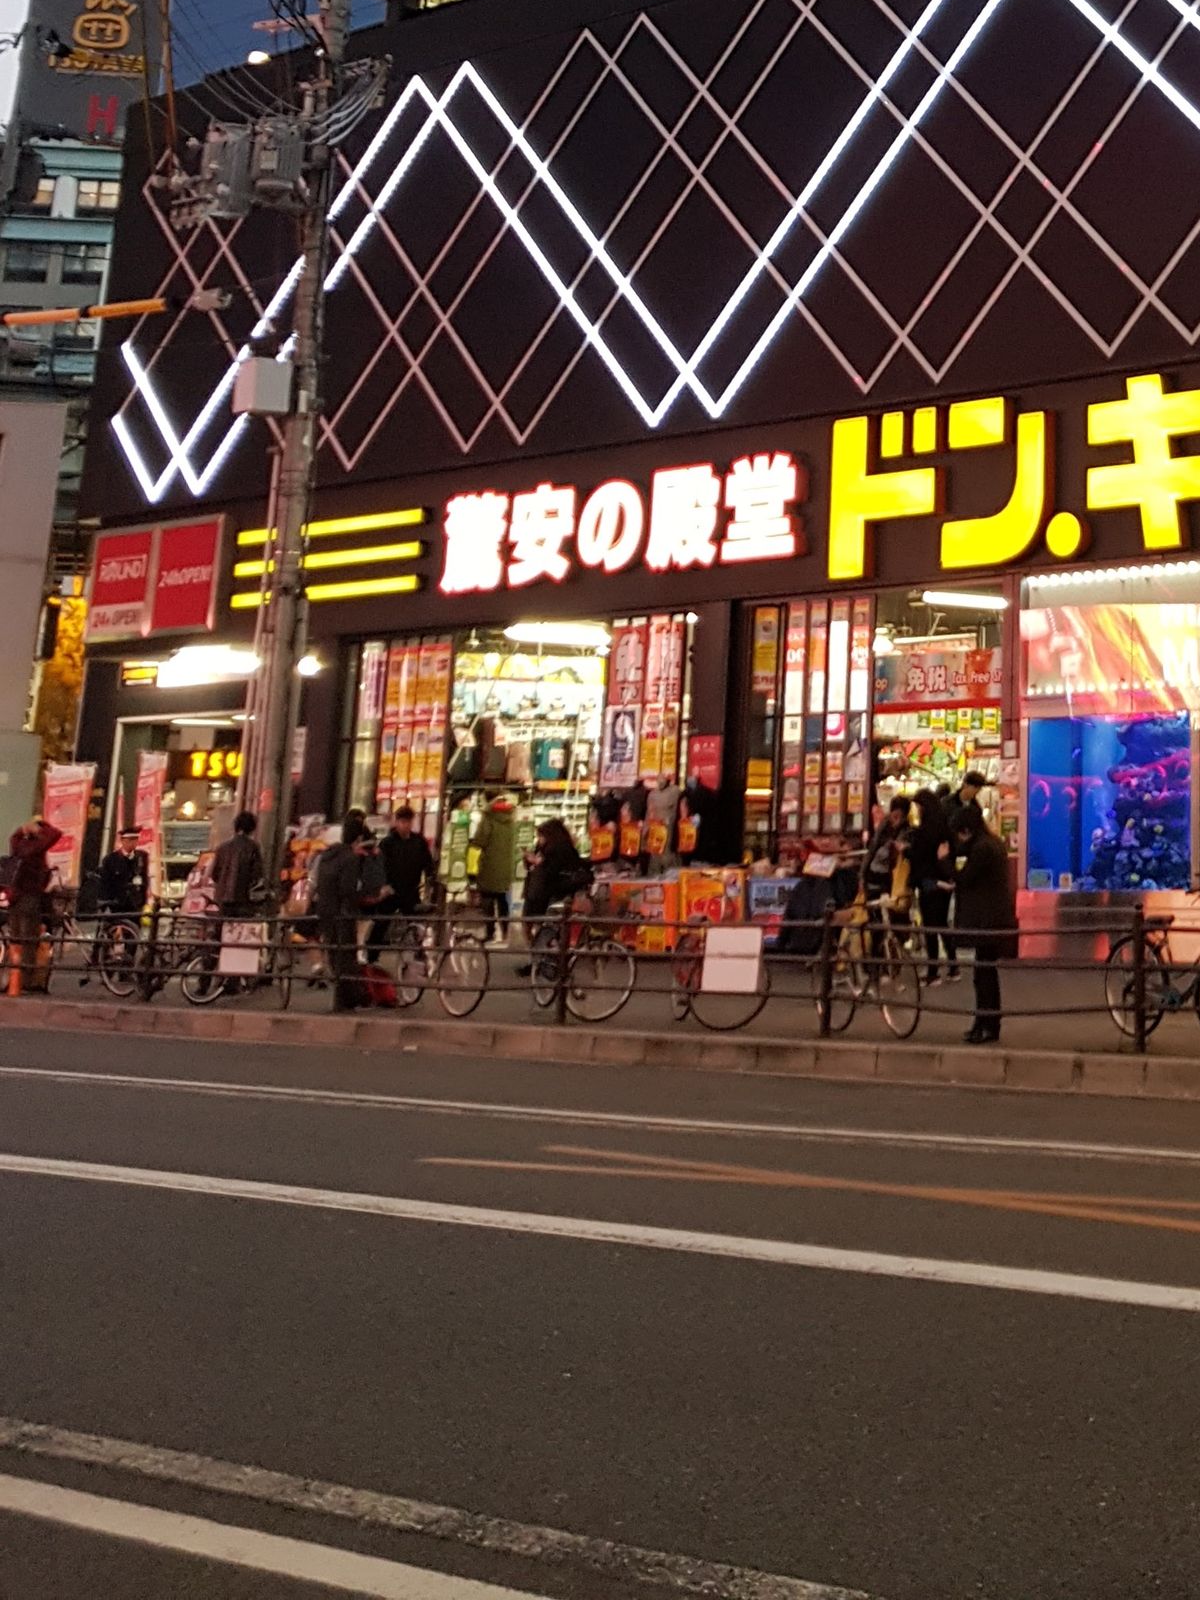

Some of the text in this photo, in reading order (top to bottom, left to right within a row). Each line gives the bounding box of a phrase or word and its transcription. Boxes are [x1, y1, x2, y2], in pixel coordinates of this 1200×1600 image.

[438, 450, 798, 593] 驚安の殿堂
